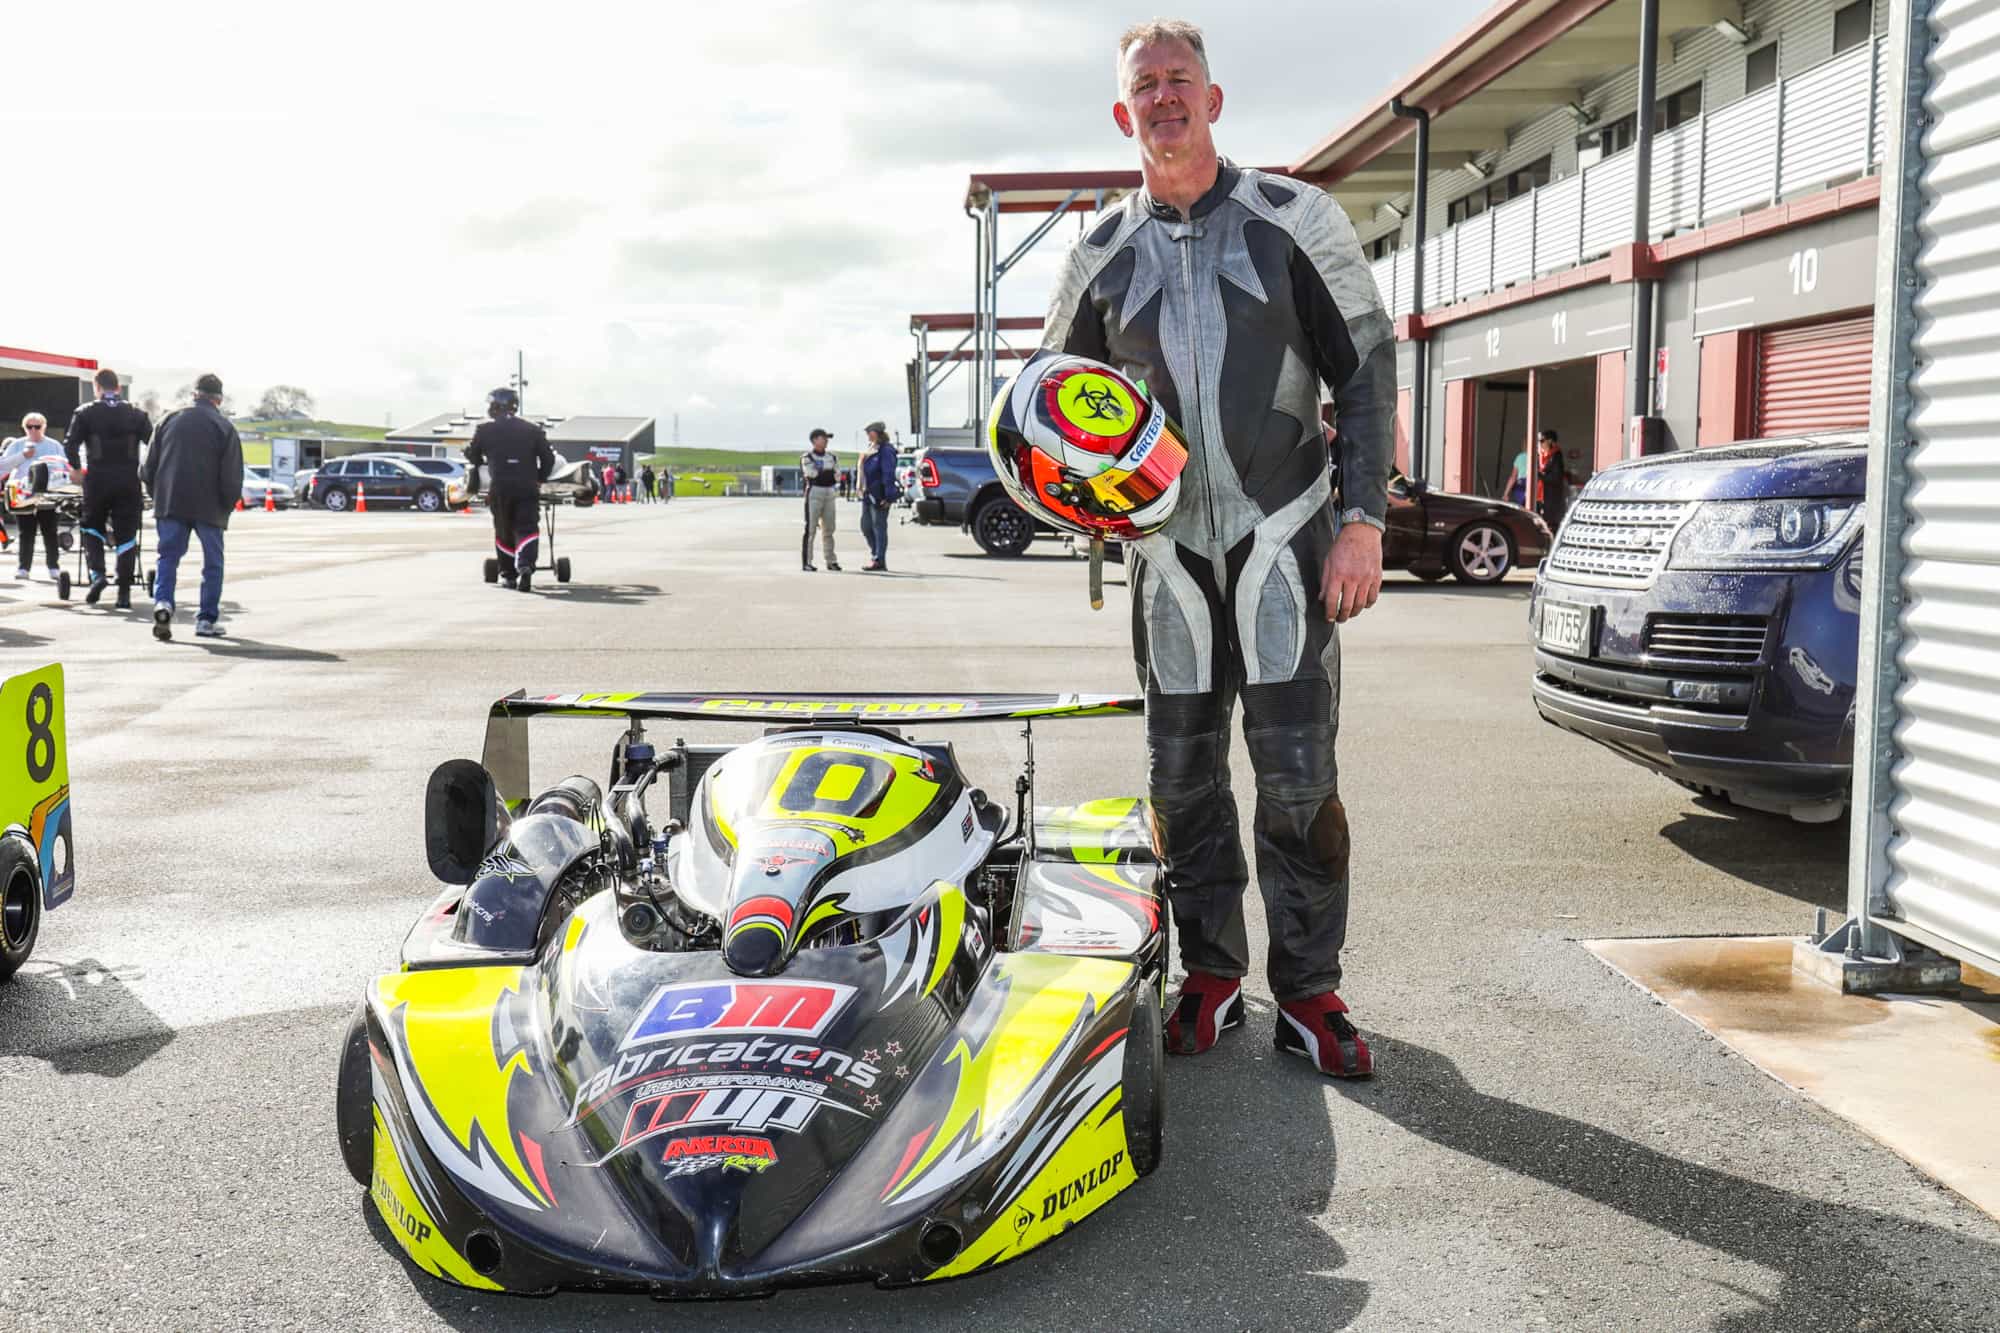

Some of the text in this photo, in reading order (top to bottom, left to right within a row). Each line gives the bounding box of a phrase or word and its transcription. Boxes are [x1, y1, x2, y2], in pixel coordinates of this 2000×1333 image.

[1789, 248, 1818, 294] 10
[1485, 328, 1500, 358] 12
[1552, 311, 1567, 344] 11
[26, 682, 55, 783] 8
[380, 1178, 432, 1244] DUNLOP
[1040, 1150, 1124, 1222] DUNLOP
